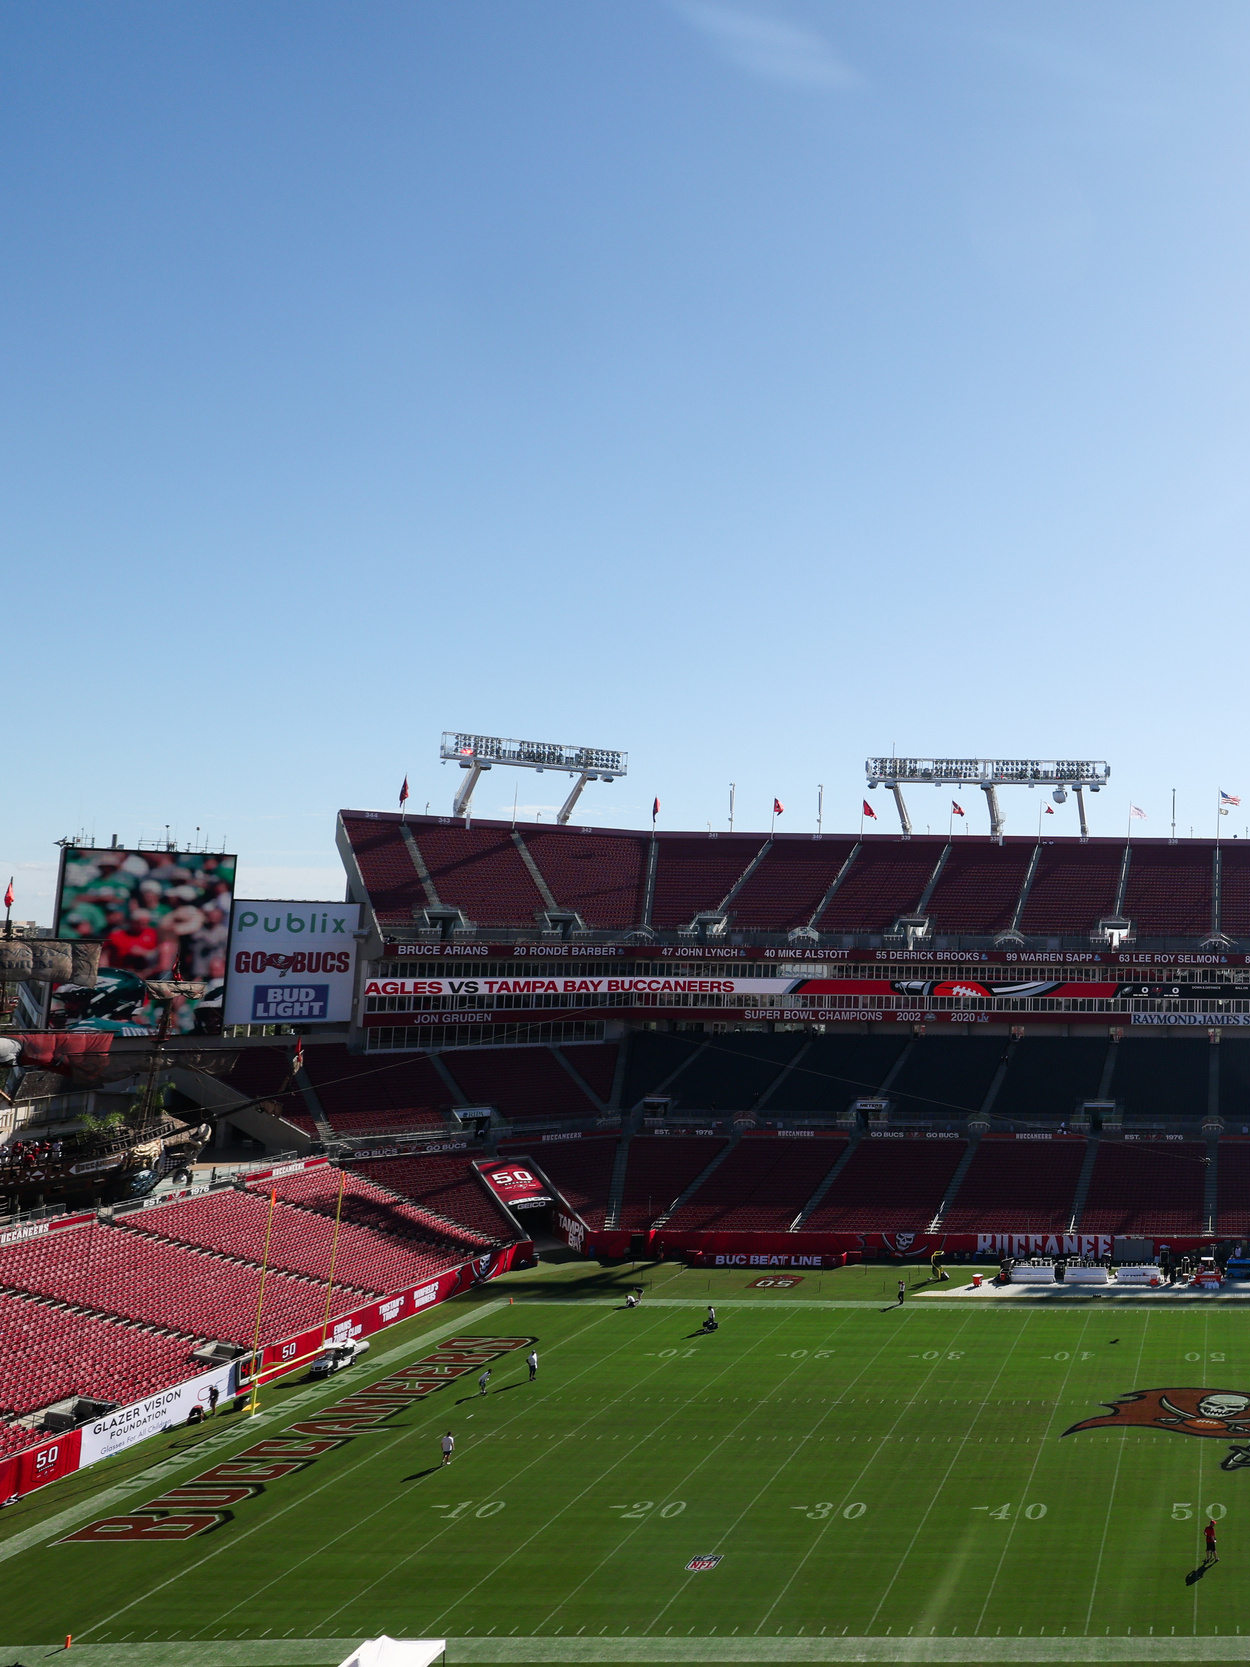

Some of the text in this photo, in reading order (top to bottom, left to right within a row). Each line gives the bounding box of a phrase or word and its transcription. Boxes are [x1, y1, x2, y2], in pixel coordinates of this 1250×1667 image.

[238, 911, 346, 934] Publix
[398, 946, 489, 956] BRUCE ARIANS
[513, 944, 616, 956] 20 RONDÉ BARBER
[661, 948, 738, 957] 47 JOHN LYNCH
[764, 949, 850, 959] 40 MIKE ALSTOTT
[876, 951, 980, 961] 55 DERRICK BROOKS
[235, 951, 349, 973] GO BUCS
[1006, 953, 1093, 962] 99 WARREN SAPP
[1119, 954, 1219, 963] 63 LEE ROY SELMON
[364, 980, 734, 995] AGLES VS TAMPA BAY BUCCANEERS
[267, 988, 316, 1002] BUD
[256, 1003, 323, 1018] LIGHT
[744, 1010, 975, 1022] SUPER BOWL CHAMPIONS 2002 2020
[414, 1013, 492, 1024] JON GRUDEN
[1133, 1015, 1196, 1025] RAYMOND
[1199, 1015, 1240, 1025] JAMES
[371, 1148, 398, 1156] BUCS
[442, 1142, 467, 1150] BUCS
[491, 1170, 533, 1184] 50
[143, 1185, 210, 1207] EST. 1976
[508, 1196, 554, 1205] GEICO
[517, 1201, 546, 1210] GEICO
[558, 1213, 584, 1240] TAMPA
[568, 1233, 582, 1253] BAY
[715, 1255, 822, 1267] BUC BEAT LINE
[282, 1342, 296, 1359] 50
[93, 1389, 182, 1435] GLAZER VISION
[110, 1408, 167, 1440] FOUNDATION
[46, 1336, 532, 1547] BUCCANEERS
[100, 1439, 125, 1458] Glasses
[126, 1433, 136, 1446] For
[137, 1430, 147, 1442] All
[35, 1446, 59, 1469] 50
[450, 1500, 506, 1519] 10
[619, 1501, 688, 1519] 20
[806, 1502, 868, 1520] 30
[986, 1503, 1048, 1520] 40
[1171, 1503, 1227, 1520] 50
[690, 1561, 713, 1570] NFL
